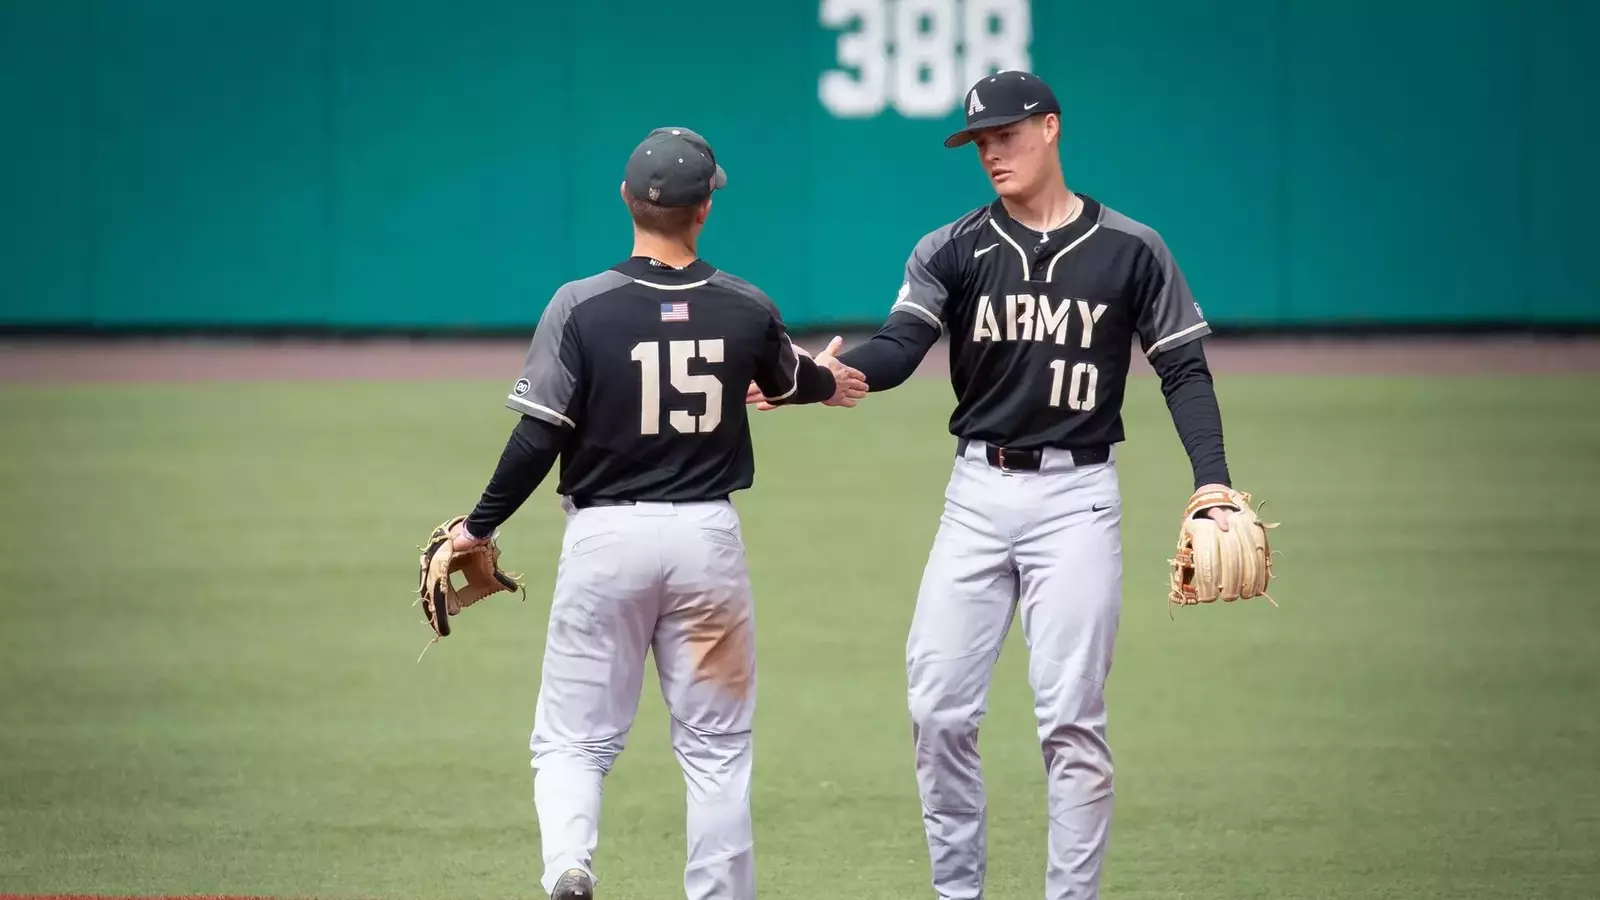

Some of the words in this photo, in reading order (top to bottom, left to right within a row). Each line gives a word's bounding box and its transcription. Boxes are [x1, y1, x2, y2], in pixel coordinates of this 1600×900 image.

[819, 0, 1031, 118] 388
[968, 89, 985, 116] A
[973, 294, 1108, 348] ARMY
[631, 339, 724, 434] 15
[1049, 359, 1098, 411] 10
